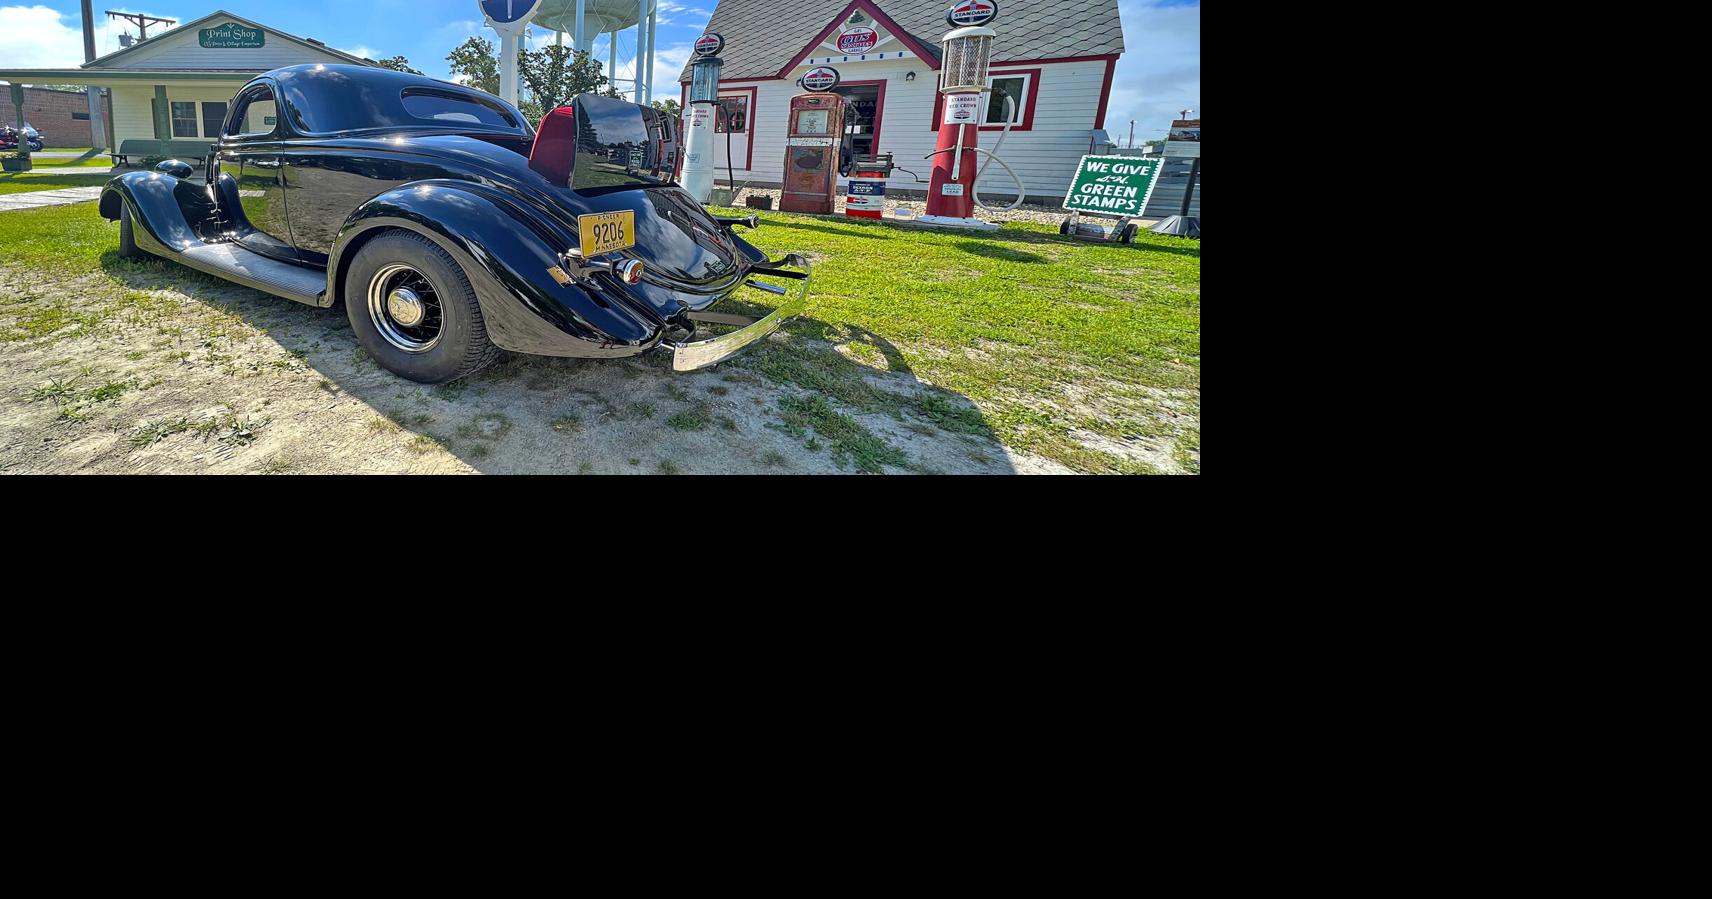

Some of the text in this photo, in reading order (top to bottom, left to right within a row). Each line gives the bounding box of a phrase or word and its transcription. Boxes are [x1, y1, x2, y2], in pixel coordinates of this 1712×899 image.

[954, 9, 991, 18] STANDARD
[206, 29, 257, 41] Print Shop
[1086, 161, 1151, 176] WE GIVE
[1080, 183, 1138, 198] GREEN
[1071, 194, 1138, 210] STAMPS
[593, 221, 624, 245] 9206
